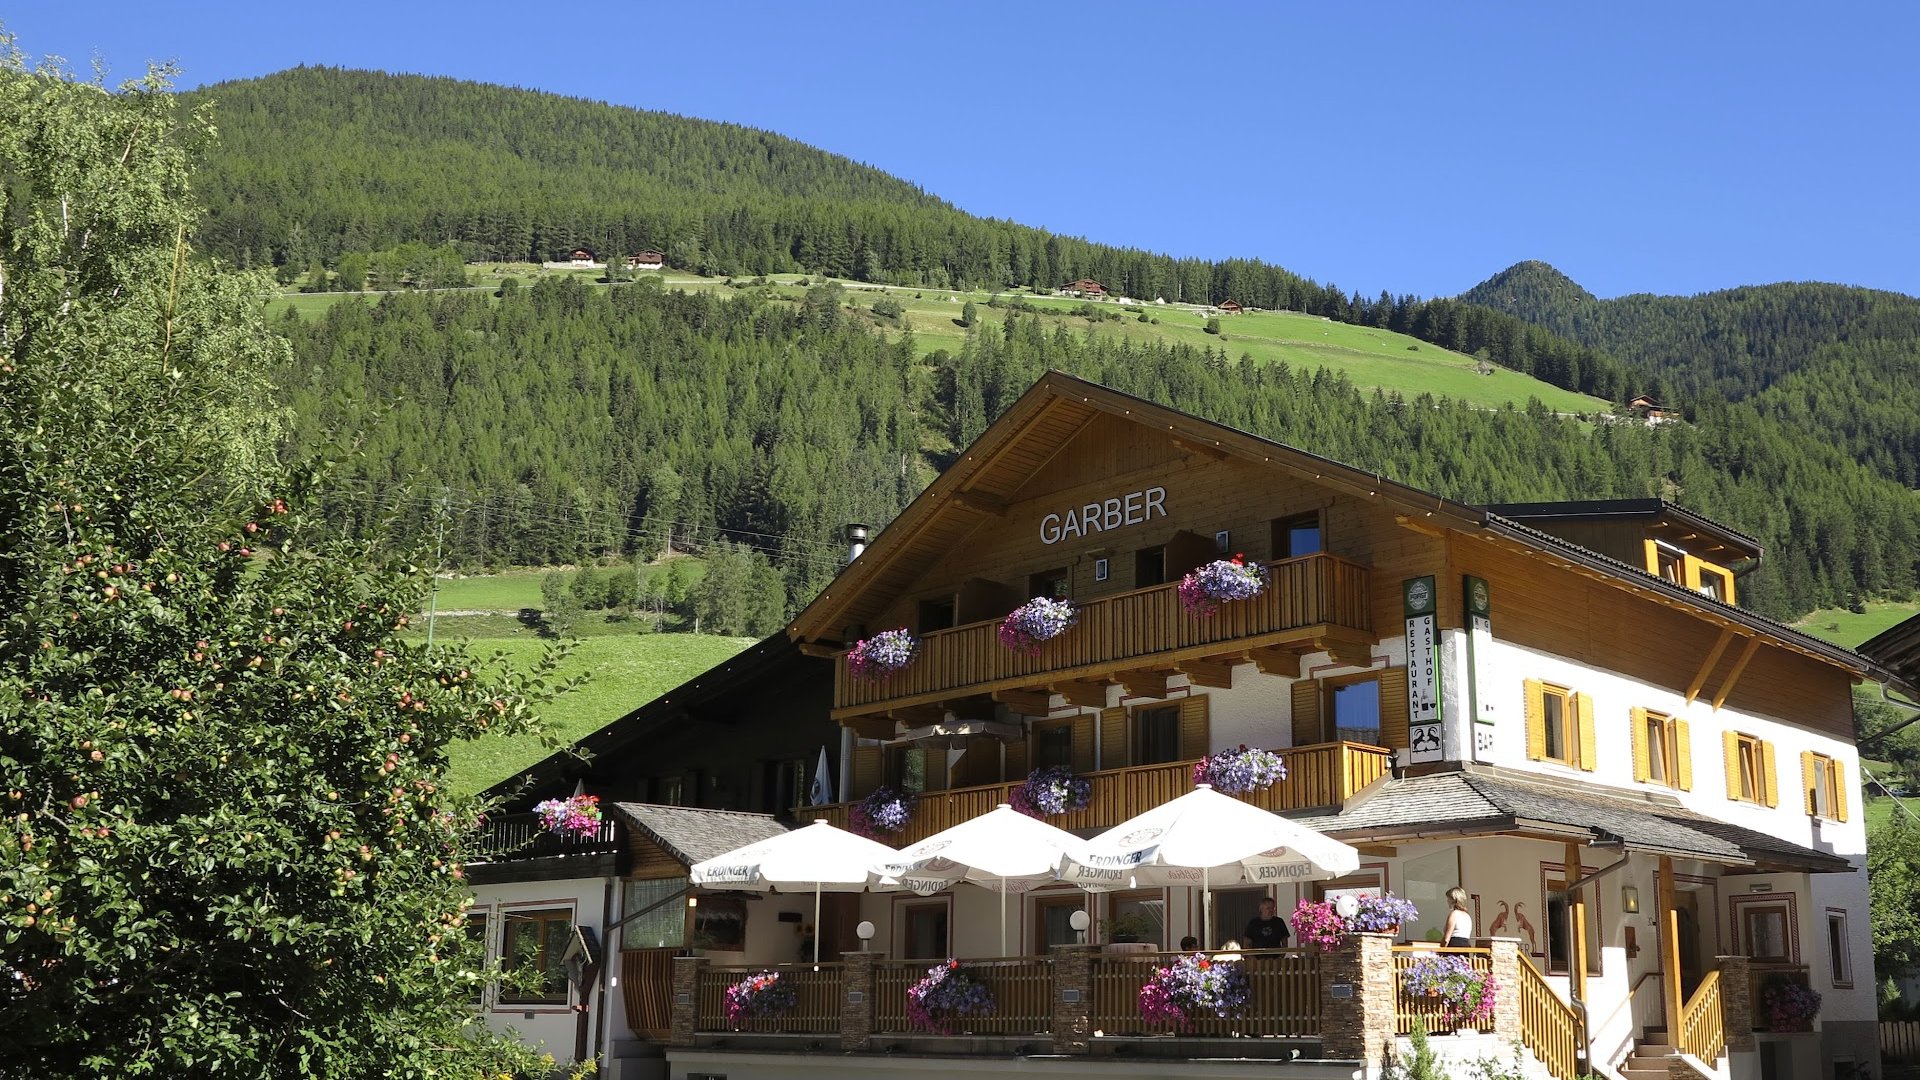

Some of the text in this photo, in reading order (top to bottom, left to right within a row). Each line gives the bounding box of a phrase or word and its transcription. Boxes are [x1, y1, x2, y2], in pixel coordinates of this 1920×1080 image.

[1039, 486, 1167, 545] GARBER
[1409, 620, 1419, 718] RESTAURANT
[1423, 617, 1433, 686] GASTHOF
[1478, 732, 1494, 753] BAR
[707, 865, 749, 877] ERDINGER
[1090, 851, 1142, 867] ERDINGER
